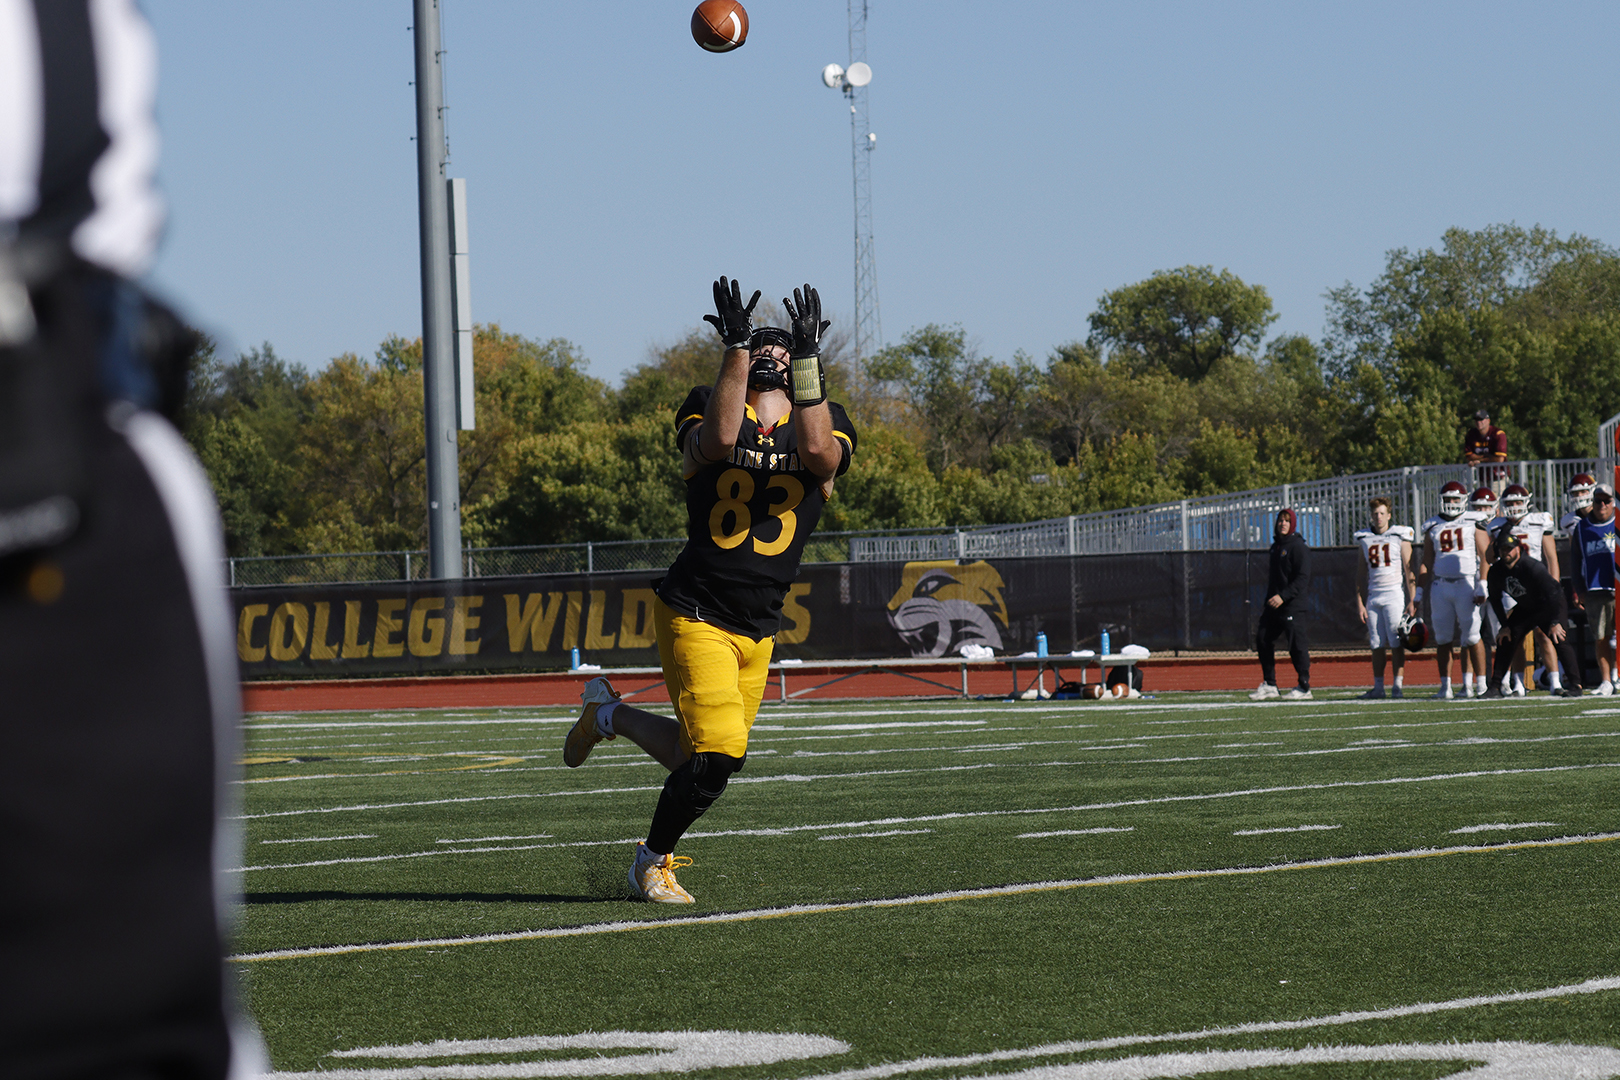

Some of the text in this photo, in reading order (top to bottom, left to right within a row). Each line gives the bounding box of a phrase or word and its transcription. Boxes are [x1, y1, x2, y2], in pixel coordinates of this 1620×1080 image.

[708, 468, 804, 556] 83
[1368, 542, 1391, 568] 81
[237, 582, 812, 662] COLLEGE WILDS
